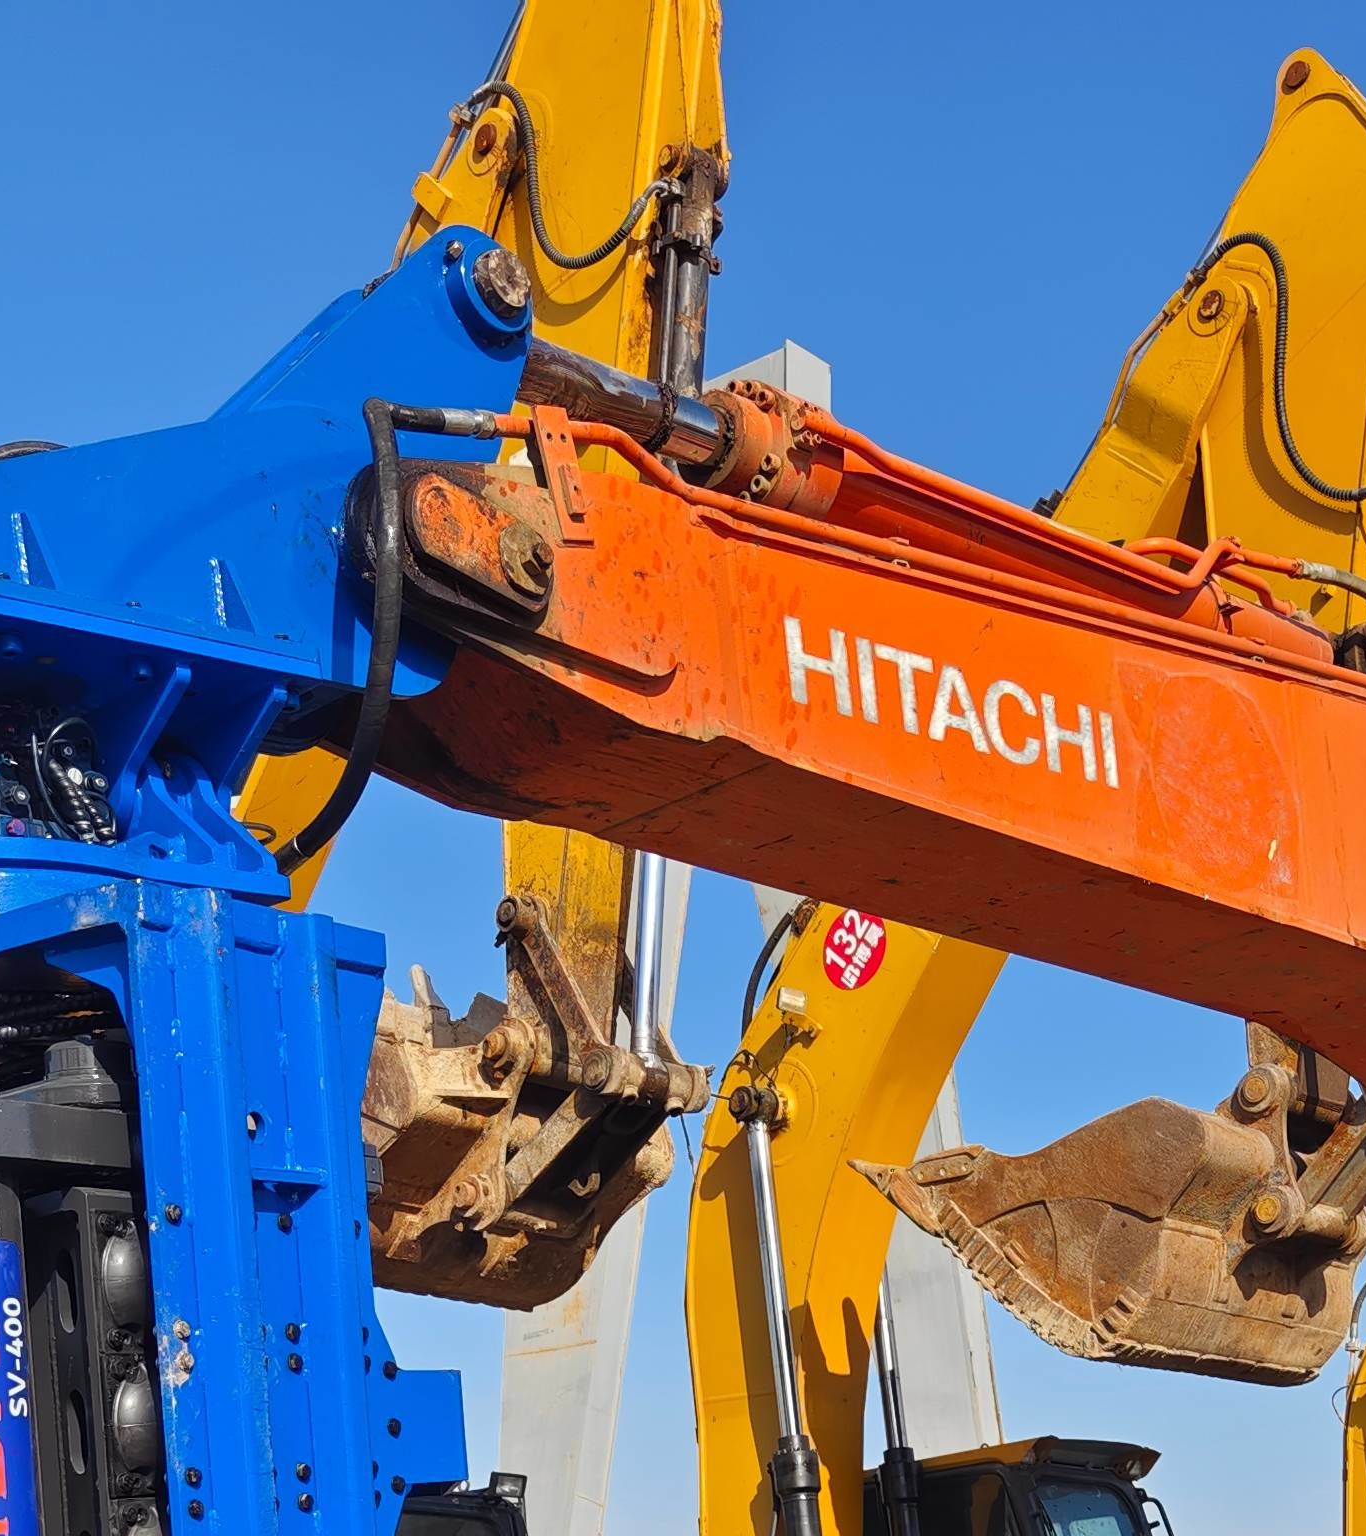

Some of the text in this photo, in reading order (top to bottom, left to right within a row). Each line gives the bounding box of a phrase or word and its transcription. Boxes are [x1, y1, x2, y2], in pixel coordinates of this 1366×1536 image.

[783, 614, 1120, 790] HITACHI
[825, 908, 870, 969] 132
[2, 1297, 28, 1418] SV-400
